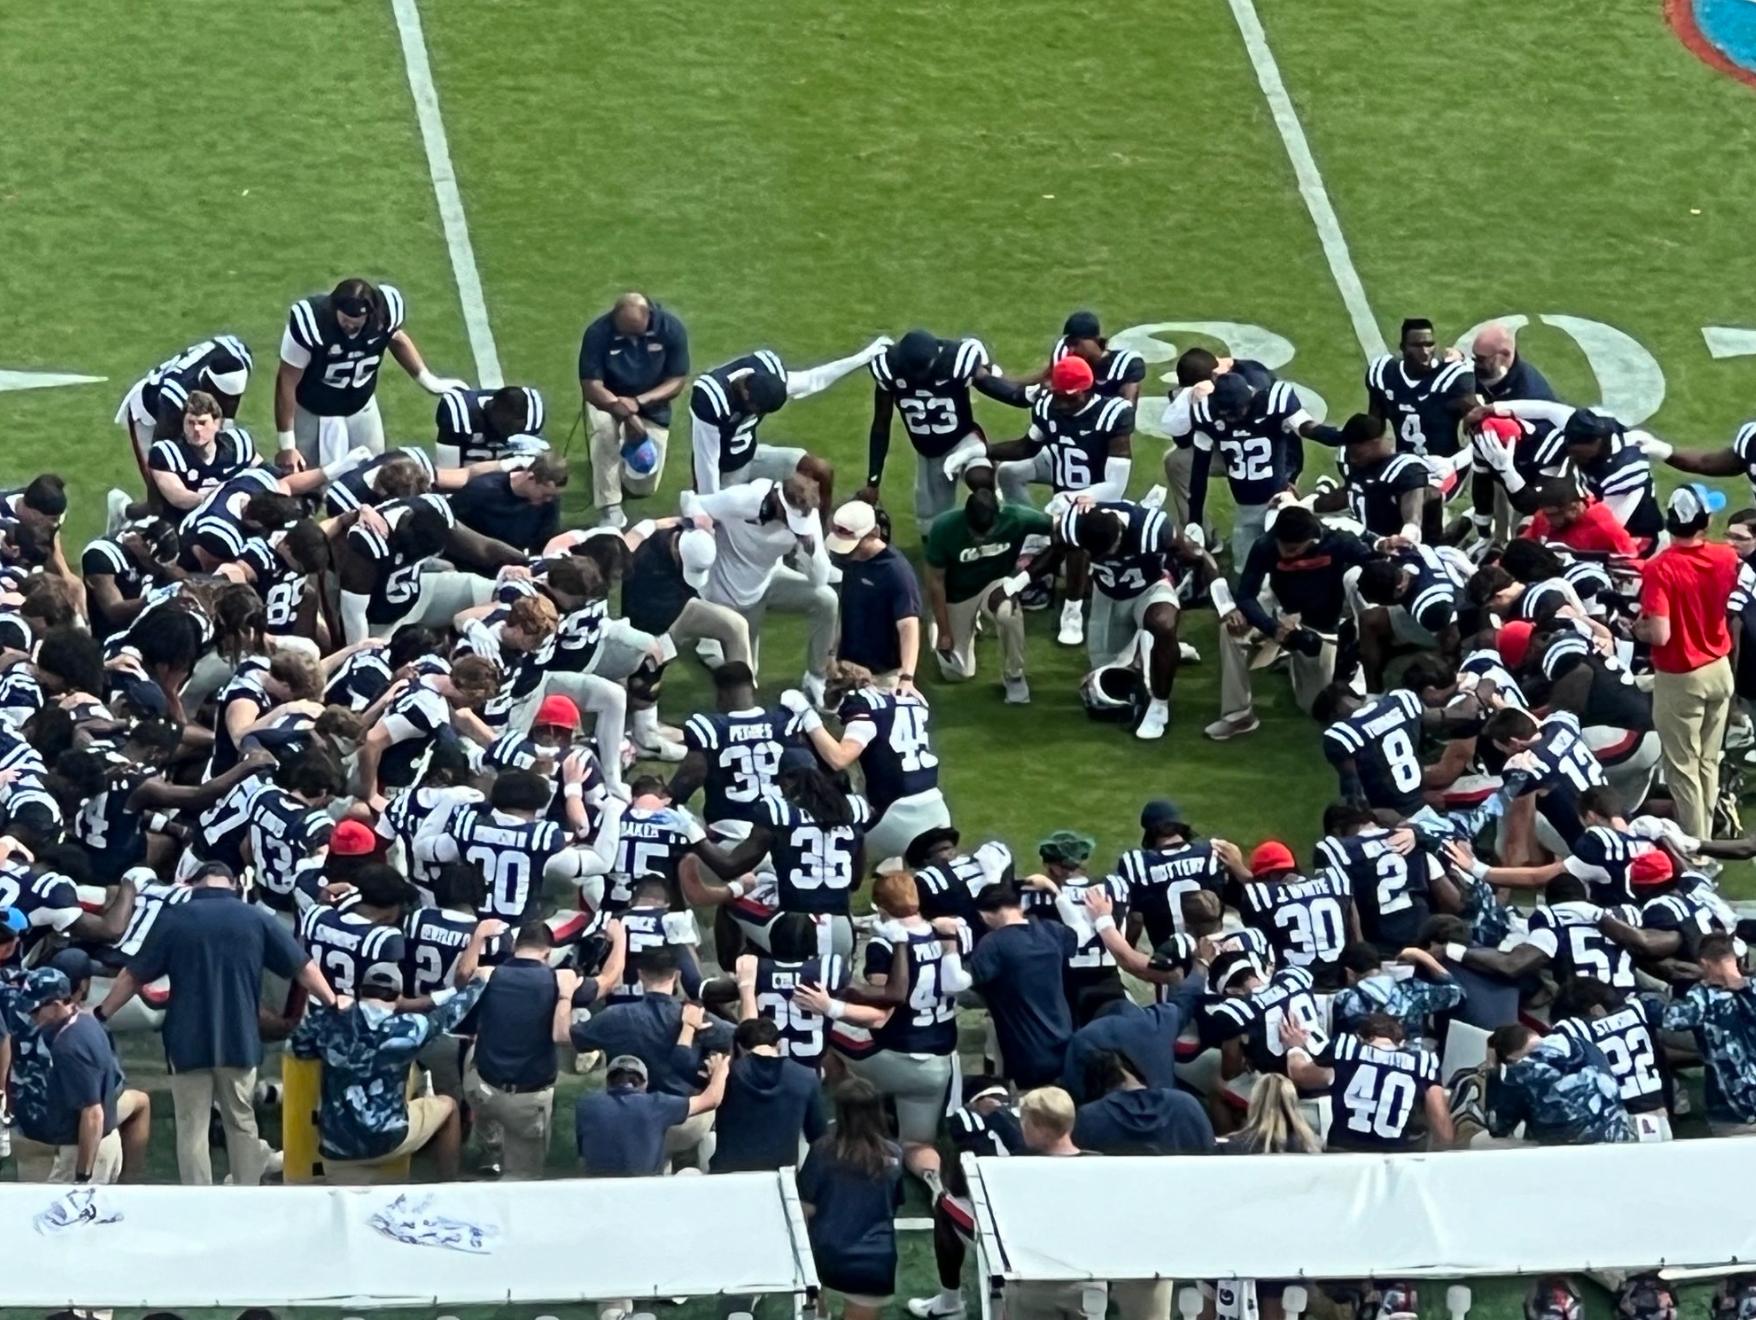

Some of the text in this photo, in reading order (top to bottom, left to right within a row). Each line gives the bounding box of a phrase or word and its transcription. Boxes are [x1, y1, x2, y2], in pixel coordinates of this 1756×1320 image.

[900, 398, 958, 436] 23
[1401, 414, 1428, 456] 4
[1050, 443, 1091, 489] 16
[1219, 437, 1273, 480] 32
[1381, 726, 1422, 793] 8
[1558, 740, 1609, 792] 12
[790, 825, 855, 889] 36
[1376, 853, 1413, 915] 2
[1274, 897, 1345, 966] 30
[1343, 1063, 1416, 1138] 40
